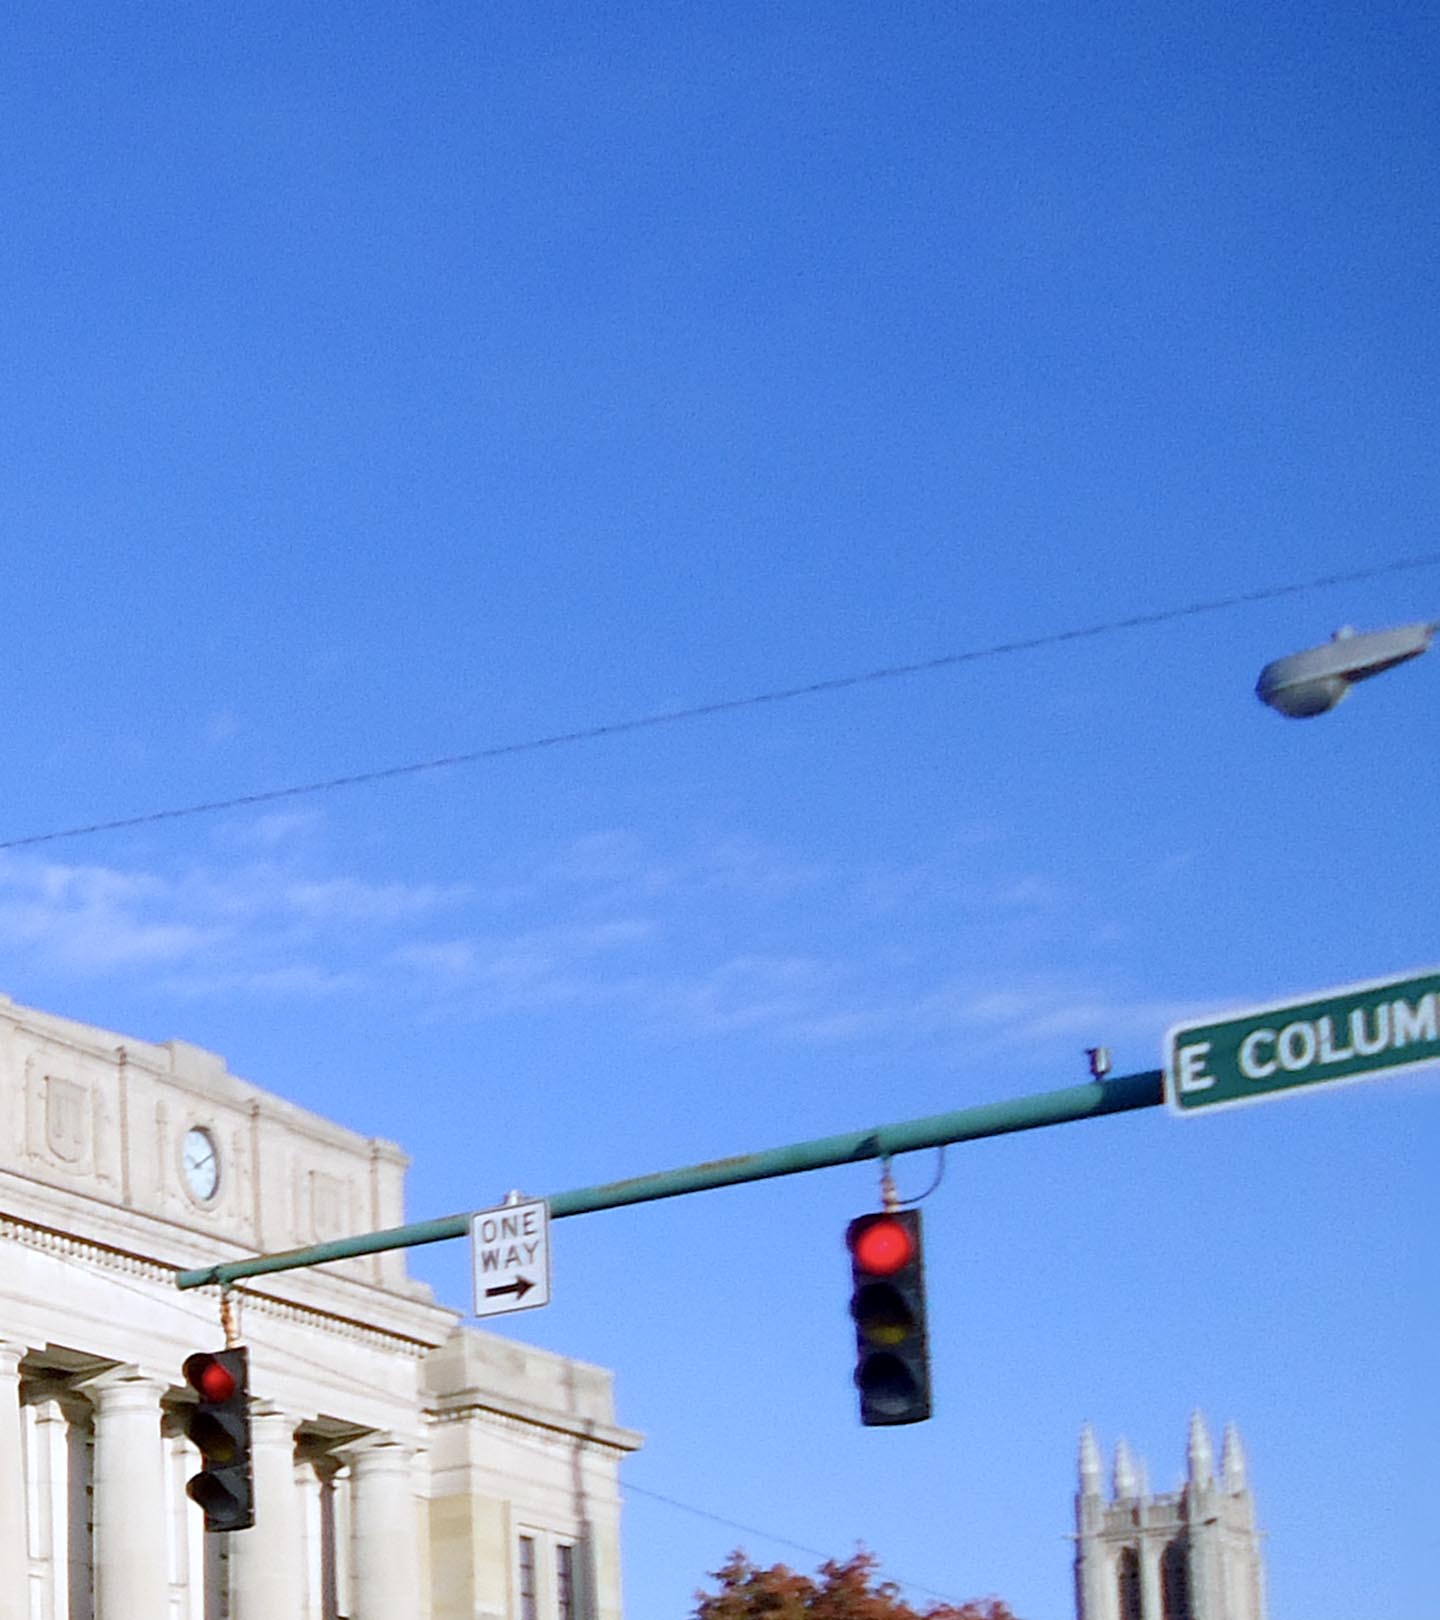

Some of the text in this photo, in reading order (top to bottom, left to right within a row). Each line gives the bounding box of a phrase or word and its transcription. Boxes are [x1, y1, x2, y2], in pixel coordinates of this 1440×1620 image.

[1179, 992, 1440, 1093] E COLUM
[482, 1210, 537, 1243] ONE
[481, 1240, 539, 1272] WAY
